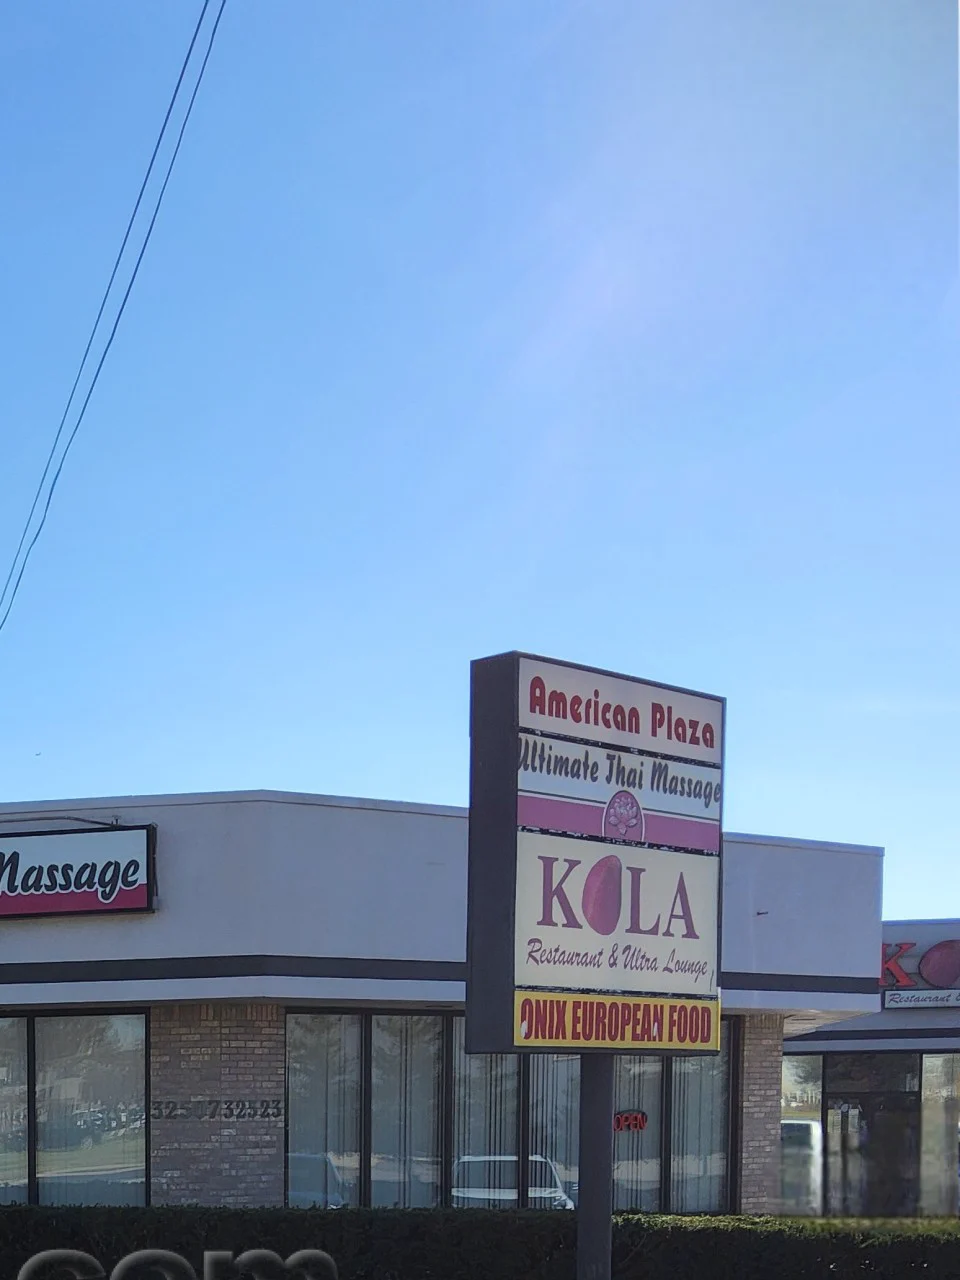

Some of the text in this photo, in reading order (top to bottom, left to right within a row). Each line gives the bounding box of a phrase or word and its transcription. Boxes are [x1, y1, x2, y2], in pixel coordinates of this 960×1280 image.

[530, 676, 714, 748] American Plaza
[517, 738, 720, 808] Ultimate Thai Massage
[537, 855, 700, 939] KOLA
[526, 937, 708, 983] Restaurant & Ultra Lounge
[520, 998, 712, 1043] ONIX EUROPEAN FOOD
[889, 993, 951, 1004] Restaurant
[613, 1113, 648, 1131] OPEN
